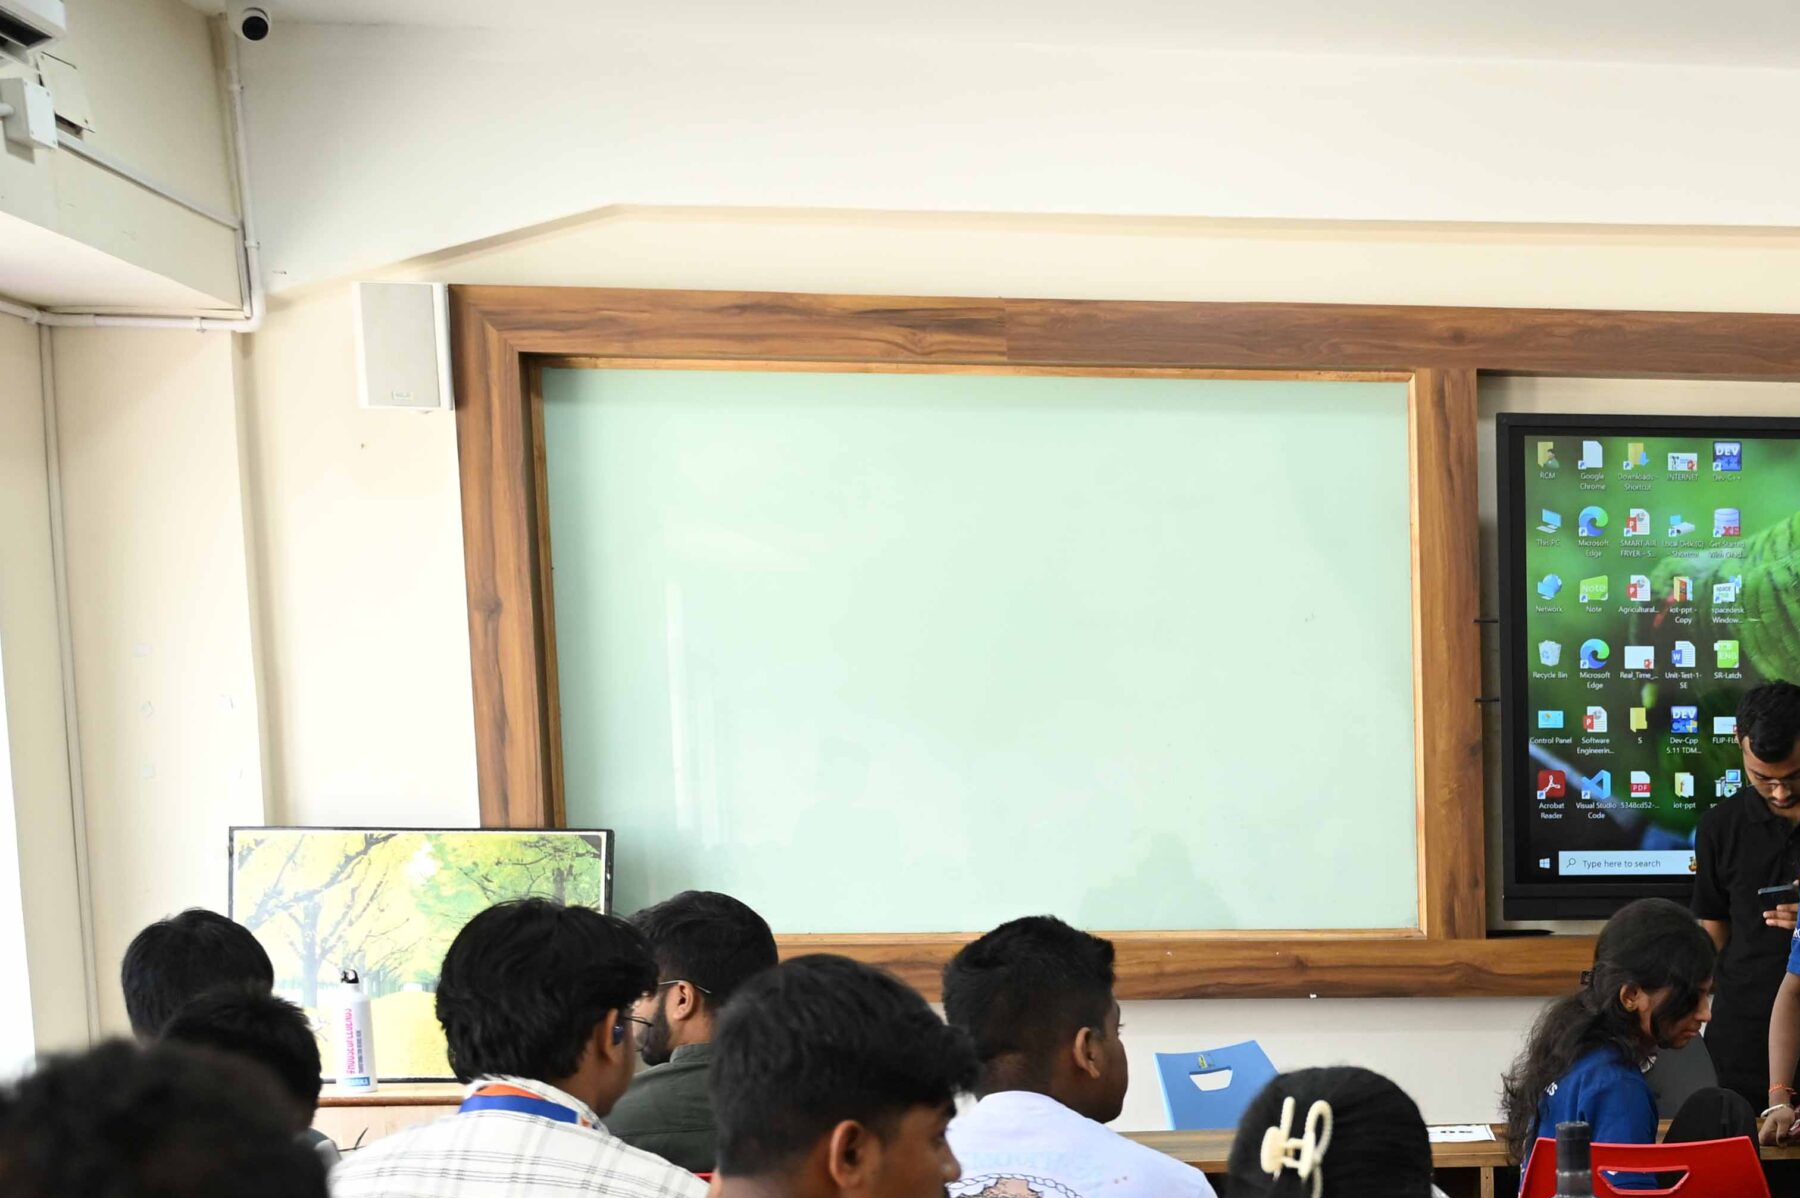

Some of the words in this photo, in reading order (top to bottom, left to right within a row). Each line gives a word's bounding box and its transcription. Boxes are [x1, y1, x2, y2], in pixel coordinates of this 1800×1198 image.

[1715, 444, 1740, 456] DEV
[1580, 473, 1604, 482] Google
[1618, 473, 1653, 481] Downloads
[1624, 483, 1652, 491] Shortcut
[1585, 550, 1602, 558] Edge
[1712, 606, 1744, 614] spacedesk
[1674, 616, 1692, 625] Copy
[1532, 672, 1554, 680] Recycle
[1587, 682, 1604, 690] Edge
[1672, 710, 1697, 719] DEV
[1670, 737, 1698, 745] Dev-Cpp
[1577, 747, 1614, 755] Engineerin...
[1632, 784, 1648, 792] PDF
[1673, 802, 1696, 810] iot-ppt
[1583, 860, 1601, 868] Type
